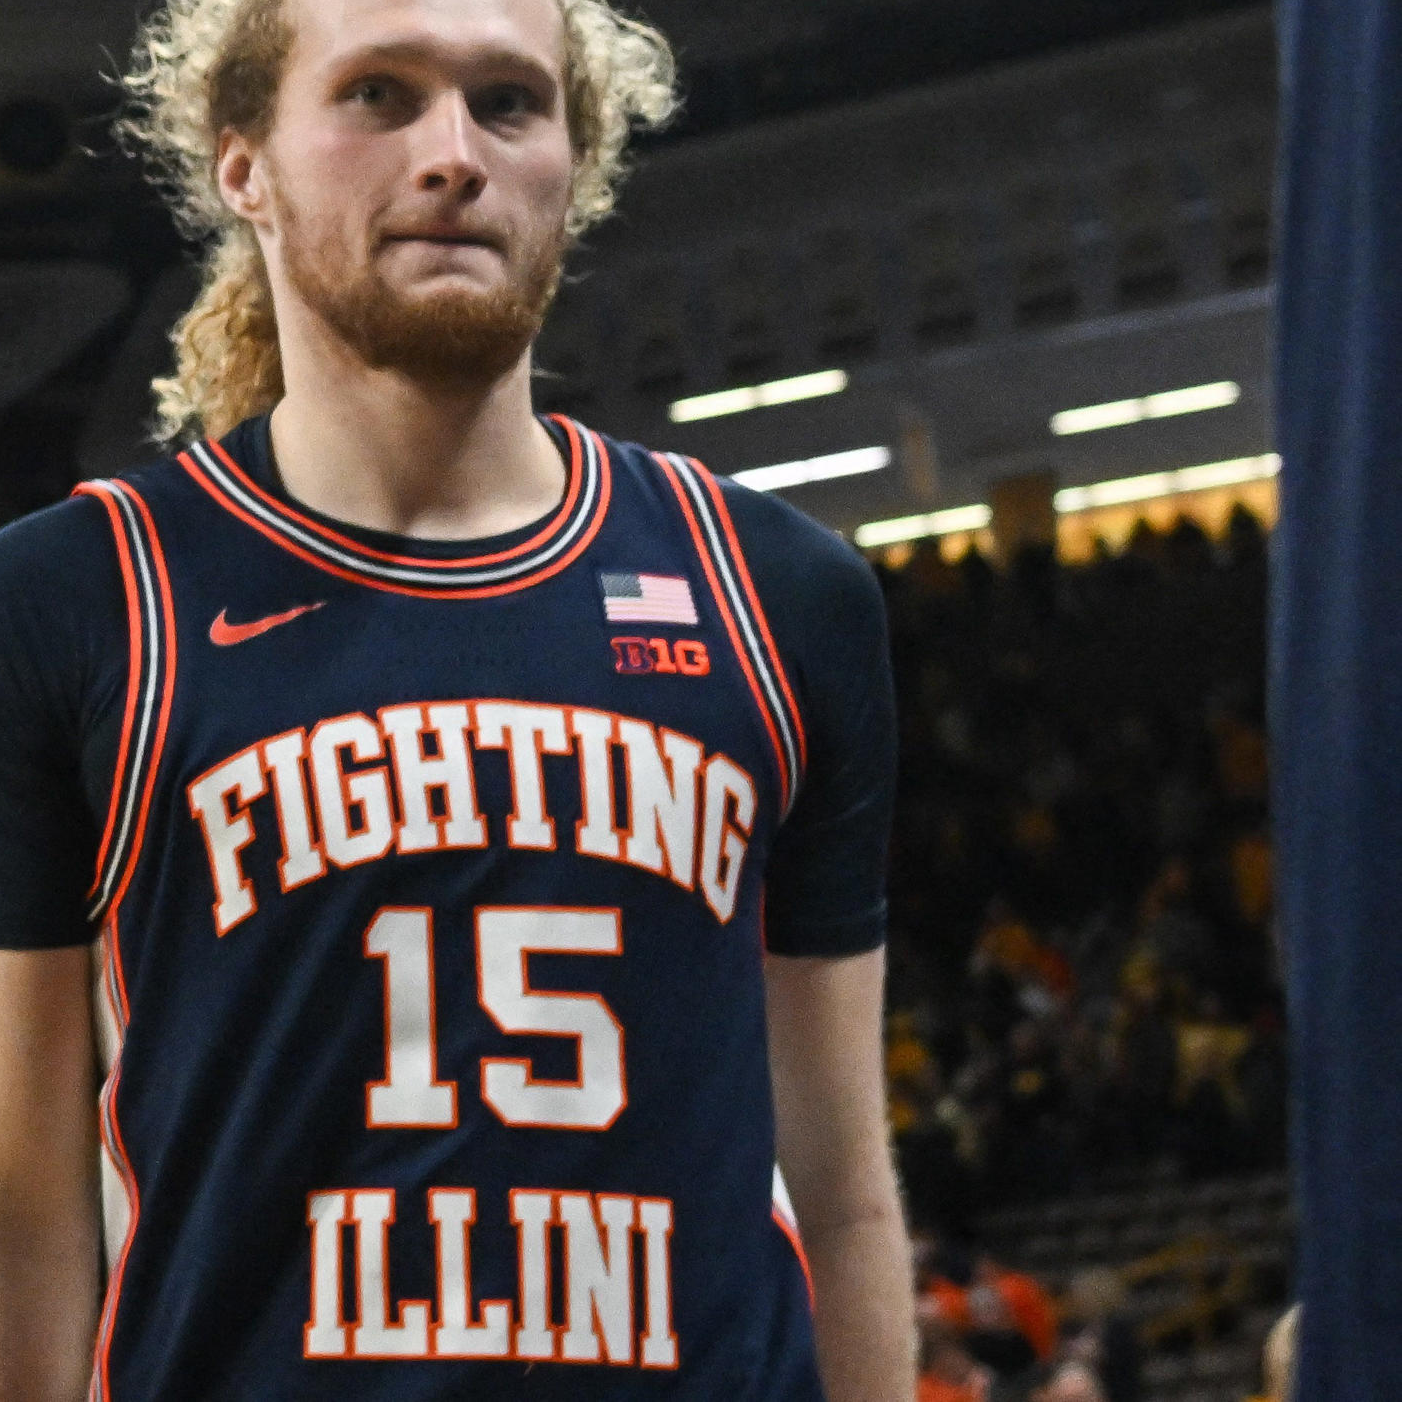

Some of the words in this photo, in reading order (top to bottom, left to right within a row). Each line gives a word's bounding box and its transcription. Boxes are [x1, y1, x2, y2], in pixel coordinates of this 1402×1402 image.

[189, 699, 758, 937] FIGHTING
[364, 907, 626, 1130] 15
[304, 1190, 678, 1369] ILLINI
